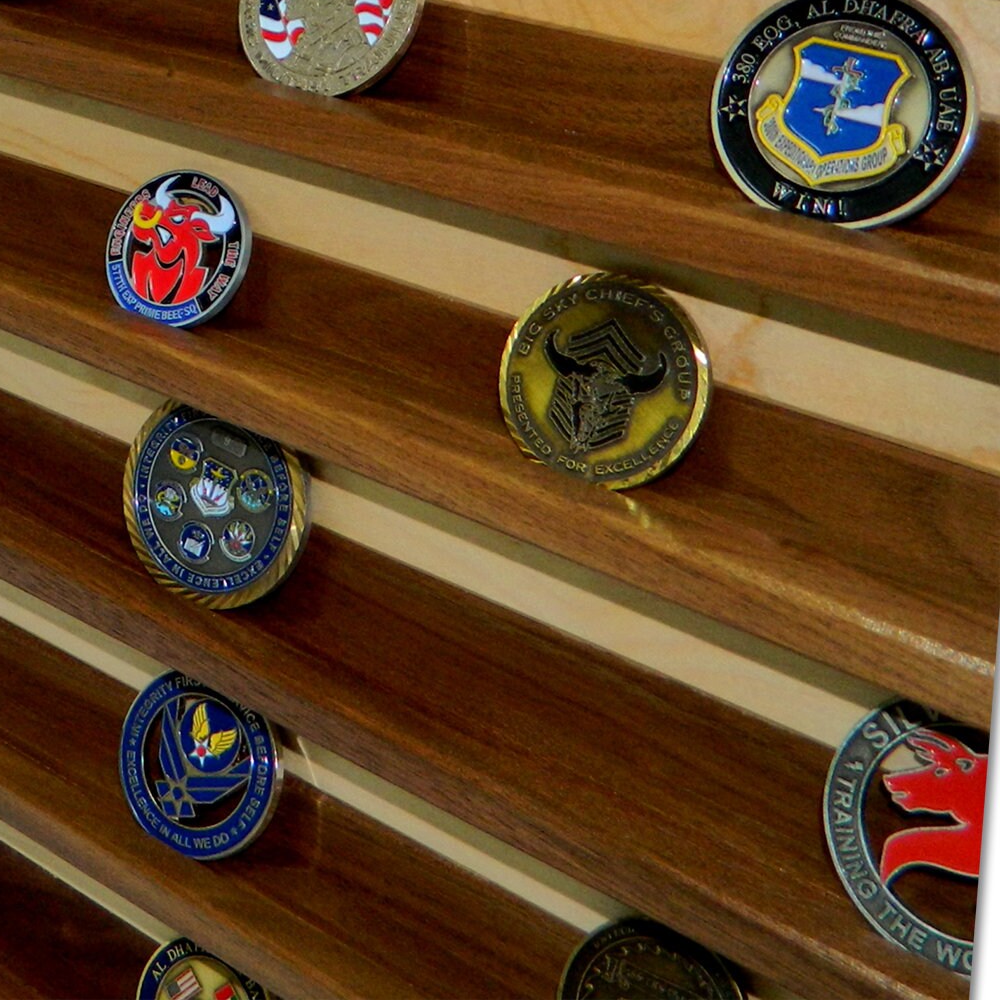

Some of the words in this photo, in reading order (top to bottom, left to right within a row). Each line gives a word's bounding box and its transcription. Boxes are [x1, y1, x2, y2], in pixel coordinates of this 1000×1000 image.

[733, 52, 757, 84] 380
[937, 86, 962, 133] UAE
[861, 147, 888, 170] GROUP
[191, 176, 219, 198] LEAD
[772, 181, 848, 216] WIN!
[223, 241, 240, 268] THE
[111, 264, 128, 292] 577TH
[122, 289, 136, 306] EXP
[134, 302, 162, 321] PRIME
[207, 273, 230, 301] WAY
[518, 323, 543, 356] BIG
[542, 293, 579, 321] SKY
[584, 288, 665, 322] CHIEF'S
[663, 325, 693, 401] GROUP
[510, 374, 553, 456] PRESENTED
[556, 455, 588, 472] FOR
[593, 421, 680, 475] EXCELLENCE
[141, 417, 181, 480] INTEGRITY
[269, 454, 289, 515] BEFORE
[138, 494, 149, 514] DO
[142, 517, 157, 541] WE
[267, 515, 288, 556] SELF
[155, 543, 175, 568] ALL
[171, 563, 185, 576] IN
[186, 558, 264, 589] EXCELLENCE
[130, 680, 174, 741] INTEGRITY
[175, 676, 201, 689] FIRS
[253, 734, 270, 797] BEFORE
[126, 750, 161, 828] EXCELLENCE
[158, 826, 171, 838] IN
[171, 832, 192, 849] ALL
[193, 837, 212, 849] WE
[212, 832, 230, 847] DO
[237, 798, 261, 830] SELF
[834, 776, 878, 900] TRAINING
[877, 902, 928, 950] THE
[151, 962, 168, 981] AL
